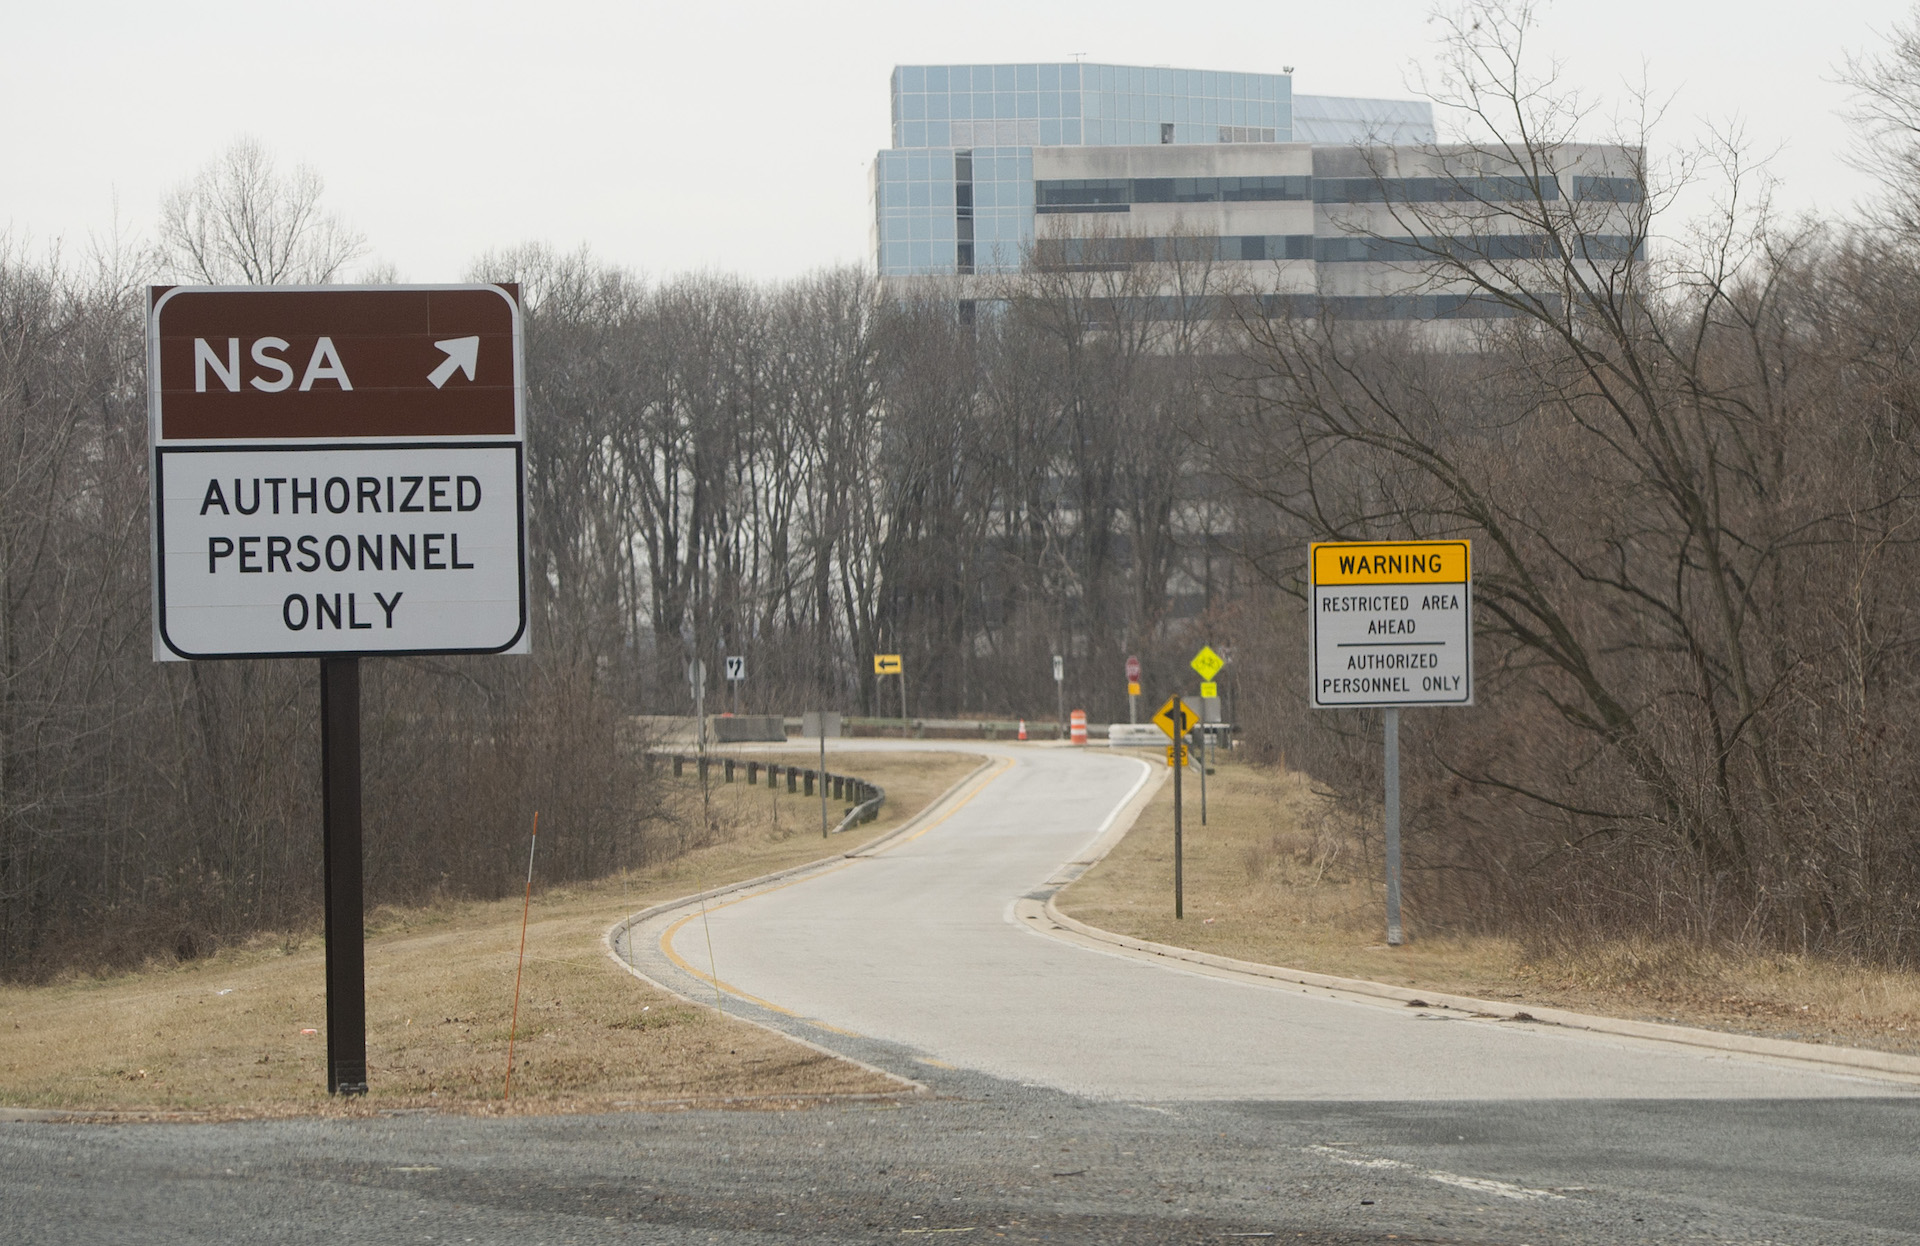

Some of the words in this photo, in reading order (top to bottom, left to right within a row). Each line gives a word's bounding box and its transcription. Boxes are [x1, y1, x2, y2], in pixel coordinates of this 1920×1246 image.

[195, 337, 353, 392] NSA
[200, 476, 481, 515] AUTHORIZED
[209, 534, 474, 573] PERSONNEL
[1340, 554, 1441, 574] WARNING
[283, 592, 403, 631] ONLY
[1323, 596, 1408, 612] RESTRICTED
[1422, 595, 1458, 609] AREA
[1368, 620, 1415, 634] AHEAD
[1348, 654, 1437, 669] AUTHORIZED
[1324, 678, 1409, 693] PERSONNEL
[1423, 676, 1459, 691] ONLY
